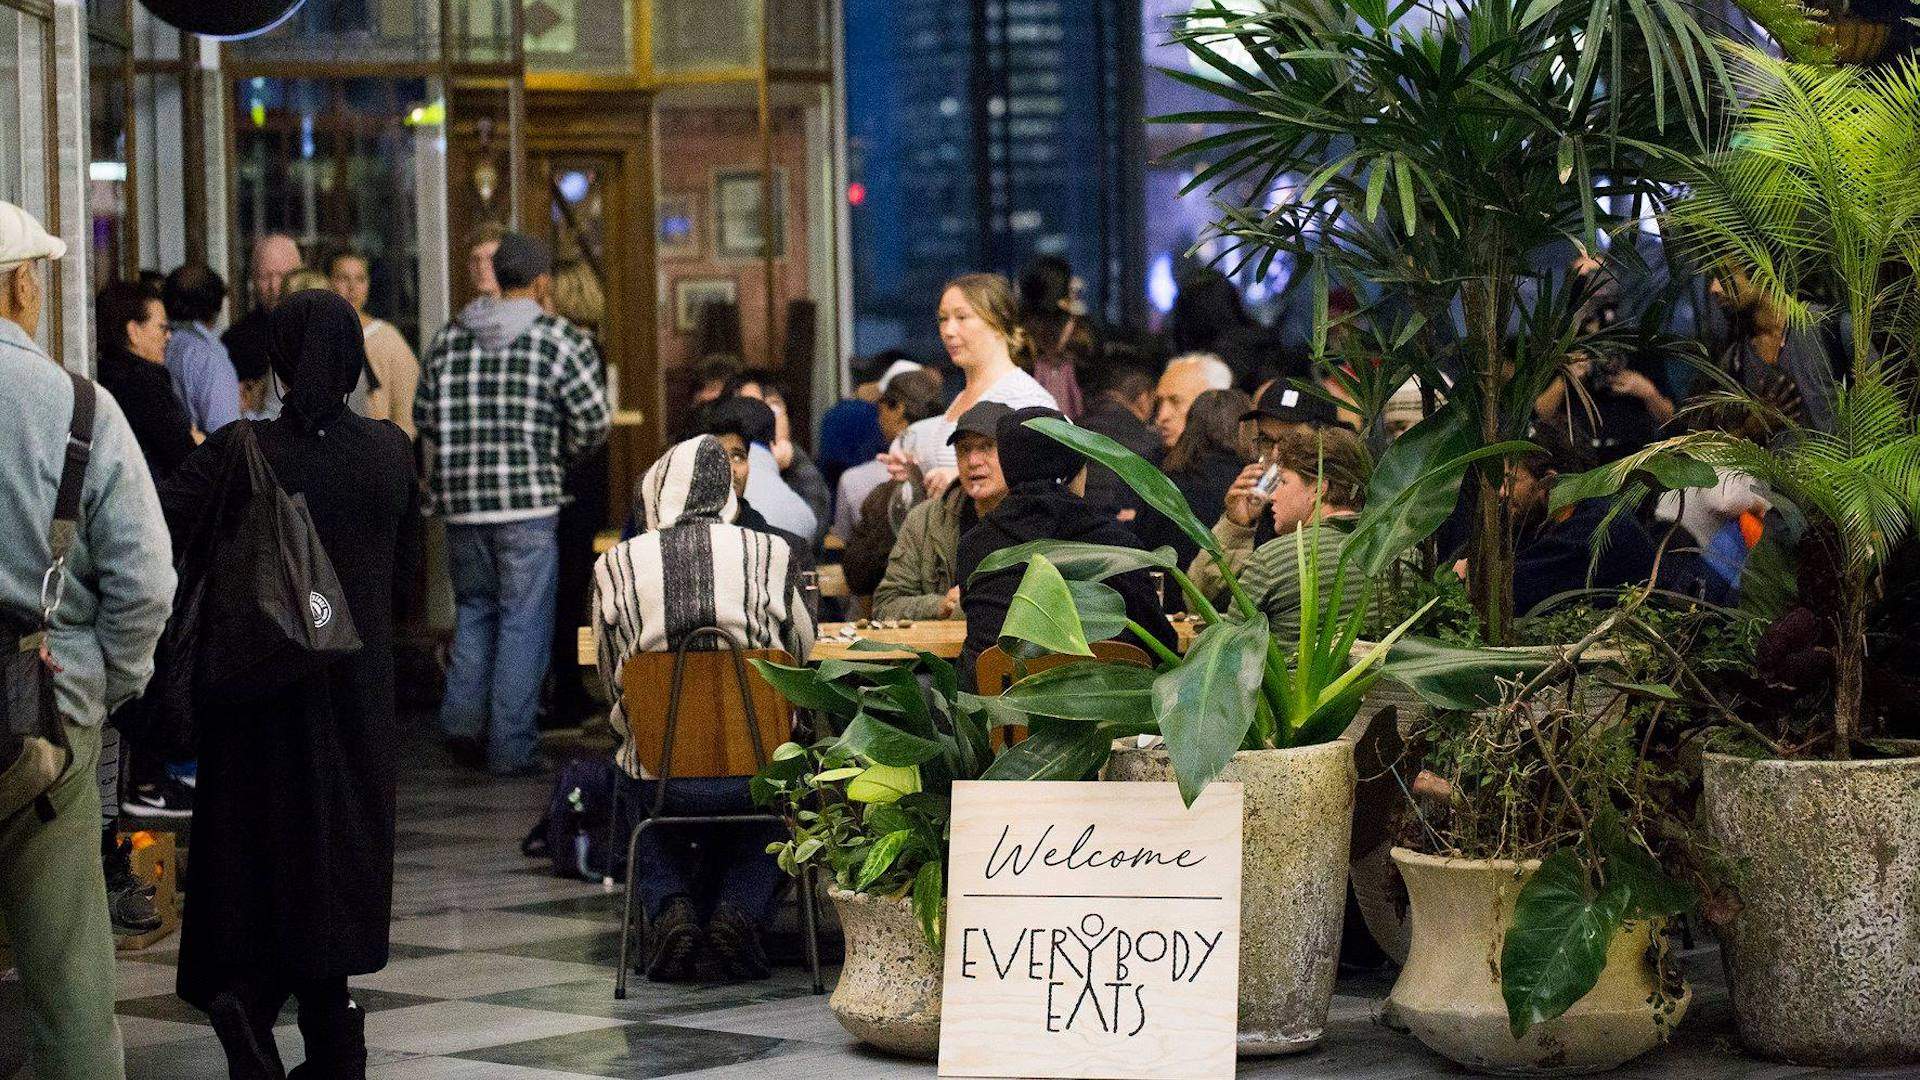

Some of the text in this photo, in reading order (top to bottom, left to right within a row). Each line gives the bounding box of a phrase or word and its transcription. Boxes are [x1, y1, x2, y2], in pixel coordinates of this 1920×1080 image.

[985, 823, 1207, 880] Welcome
[962, 914, 1223, 983] EVERYBODY
[1046, 981, 1146, 1037] EATS
